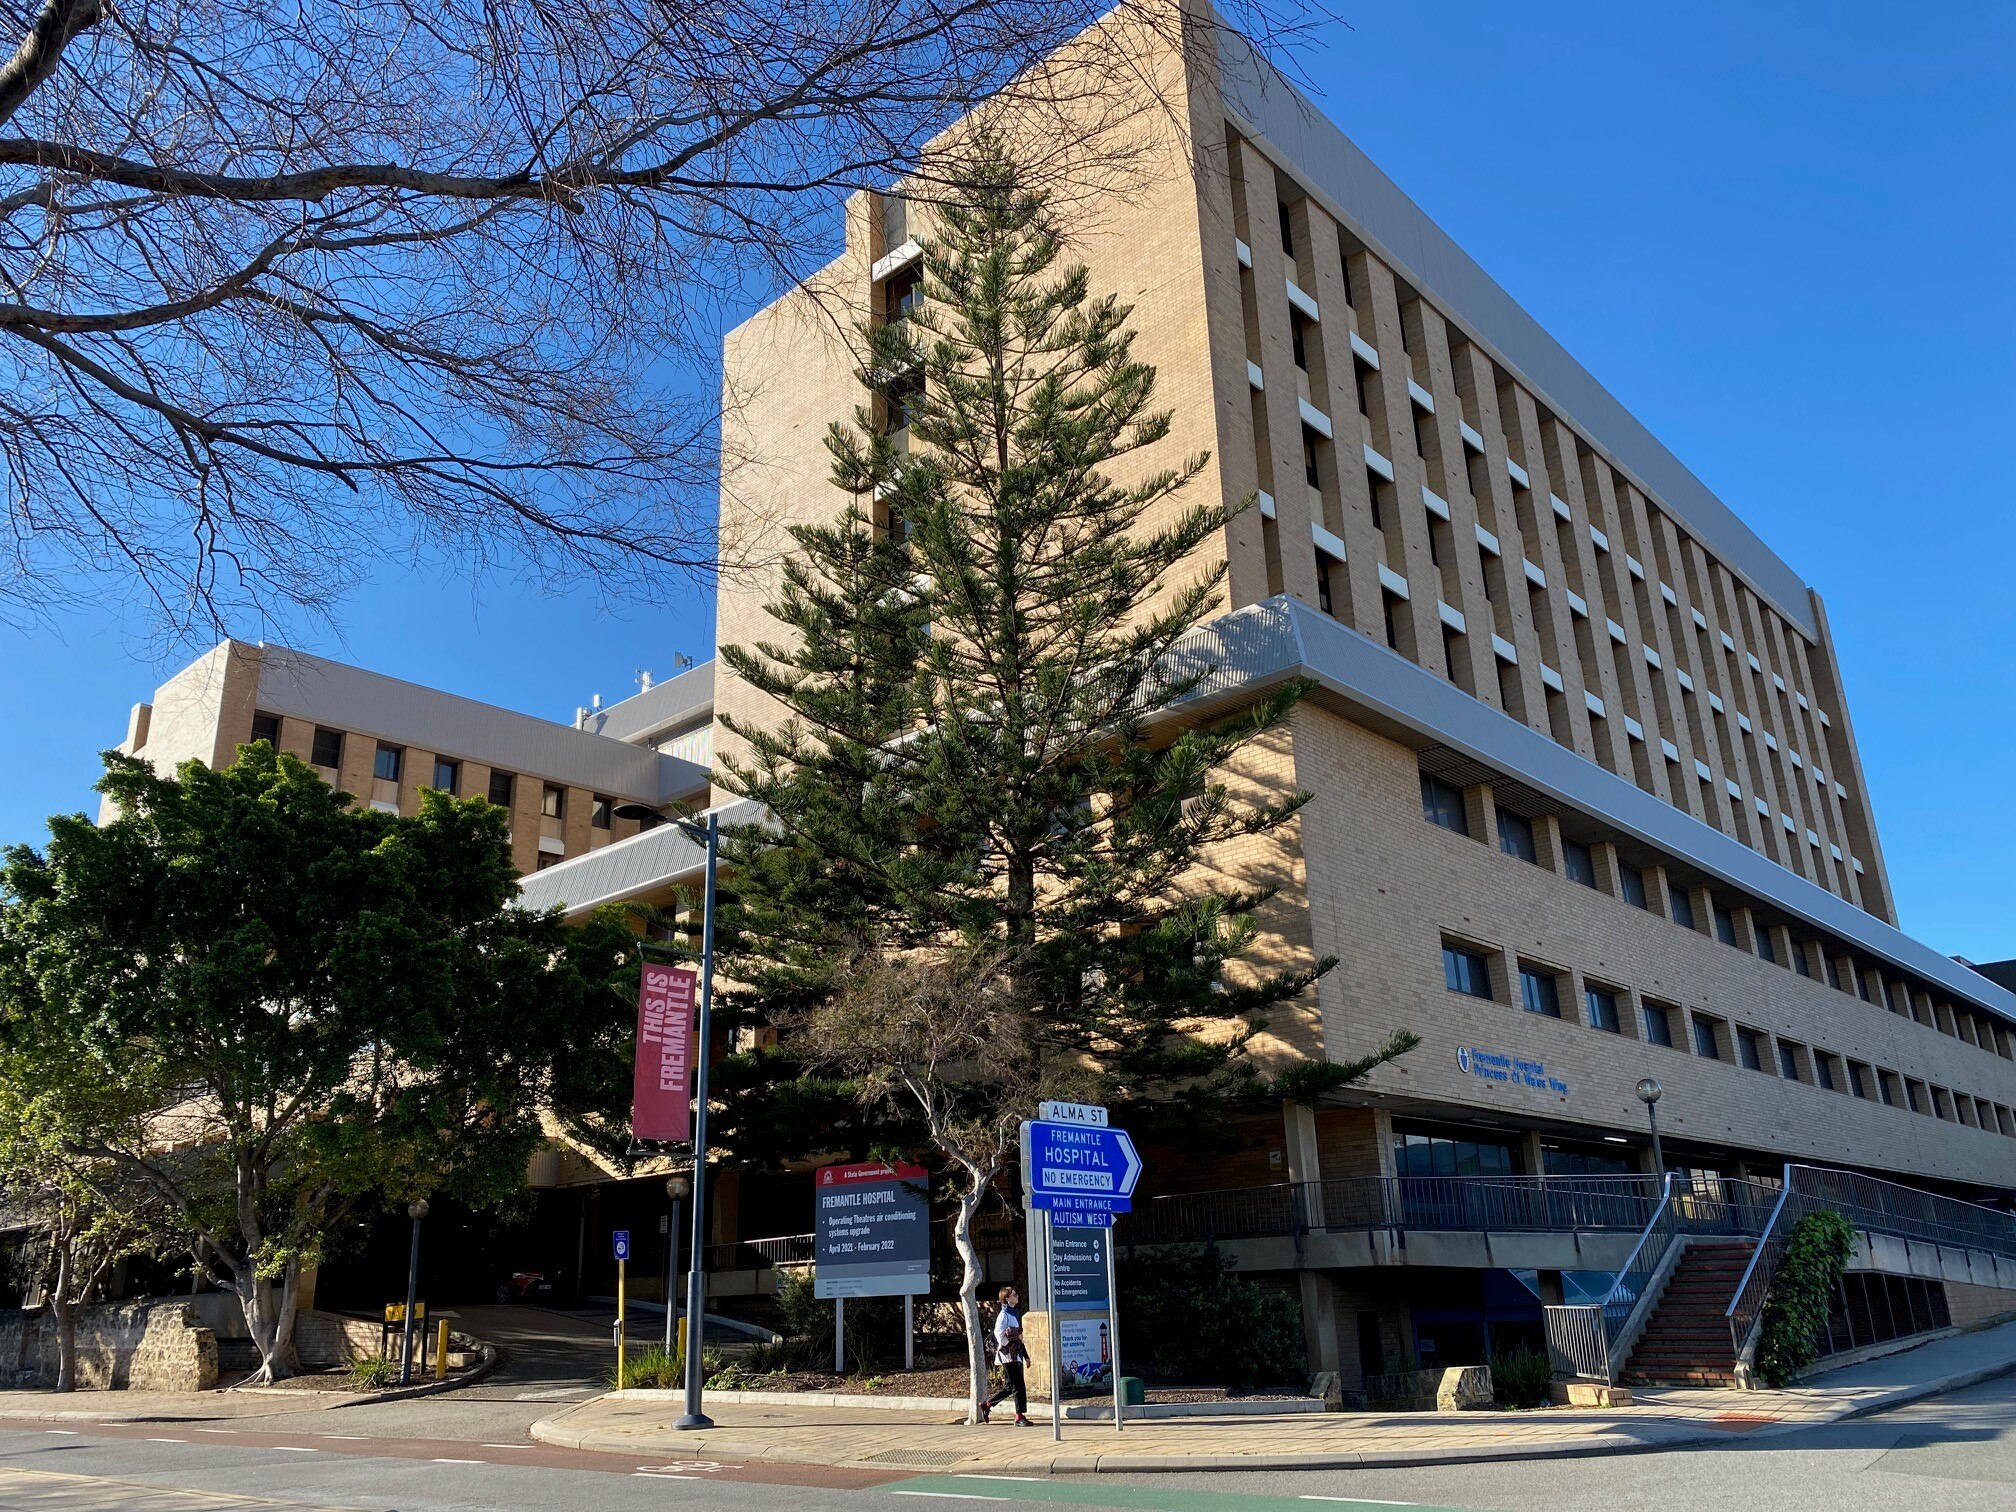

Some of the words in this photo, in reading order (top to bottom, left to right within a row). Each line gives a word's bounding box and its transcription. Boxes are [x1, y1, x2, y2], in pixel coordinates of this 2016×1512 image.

[647, 972, 668, 994] IS
[643, 998, 666, 1044] THIS
[660, 975, 690, 1092] FREMANTLE
[1471, 1047, 1510, 1068] Fremantle
[1514, 1057, 1544, 1075] Hospital
[1474, 1062, 1508, 1081] Princess
[1524, 1072, 1546, 1088] Wales
[1549, 1078, 1568, 1095] Wing
[1053, 1105, 1085, 1120] ALMA
[1091, 1110, 1103, 1122] ST
[1051, 1130, 1101, 1146] FREMANTLE
[1045, 1146, 1108, 1166] HOSPITAL
[1044, 1171, 1056, 1183] NO
[1060, 1173, 1111, 1187] EMERGENCY
[822, 1193, 861, 1209] FREMANTLE
[863, 1190, 895, 1205] HOSPITAL
[1052, 1198, 1072, 1208] MAIN
[1075, 1198, 1112, 1210] ENTRANCE
[828, 1215, 853, 1226] Operating
[854, 1214, 875, 1224] Theatres
[885, 1210, 916, 1221] conditioning
[1054, 1212, 1083, 1224] AUTISM
[1087, 1213, 1106, 1226] WEST
[828, 1228, 849, 1239] systems
[850, 1226, 870, 1237] upgrade
[828, 1244, 840, 1254] April
[841, 1243, 854, 1252] 2021
[857, 1242, 880, 1252] February
[881, 1240, 894, 1250] 2022
[1053, 1240, 1064, 1248] Main
[1065, 1240, 1087, 1248] Entrance
[1053, 1254, 1063, 1262] Day
[1054, 1264, 1070, 1272] Centre
